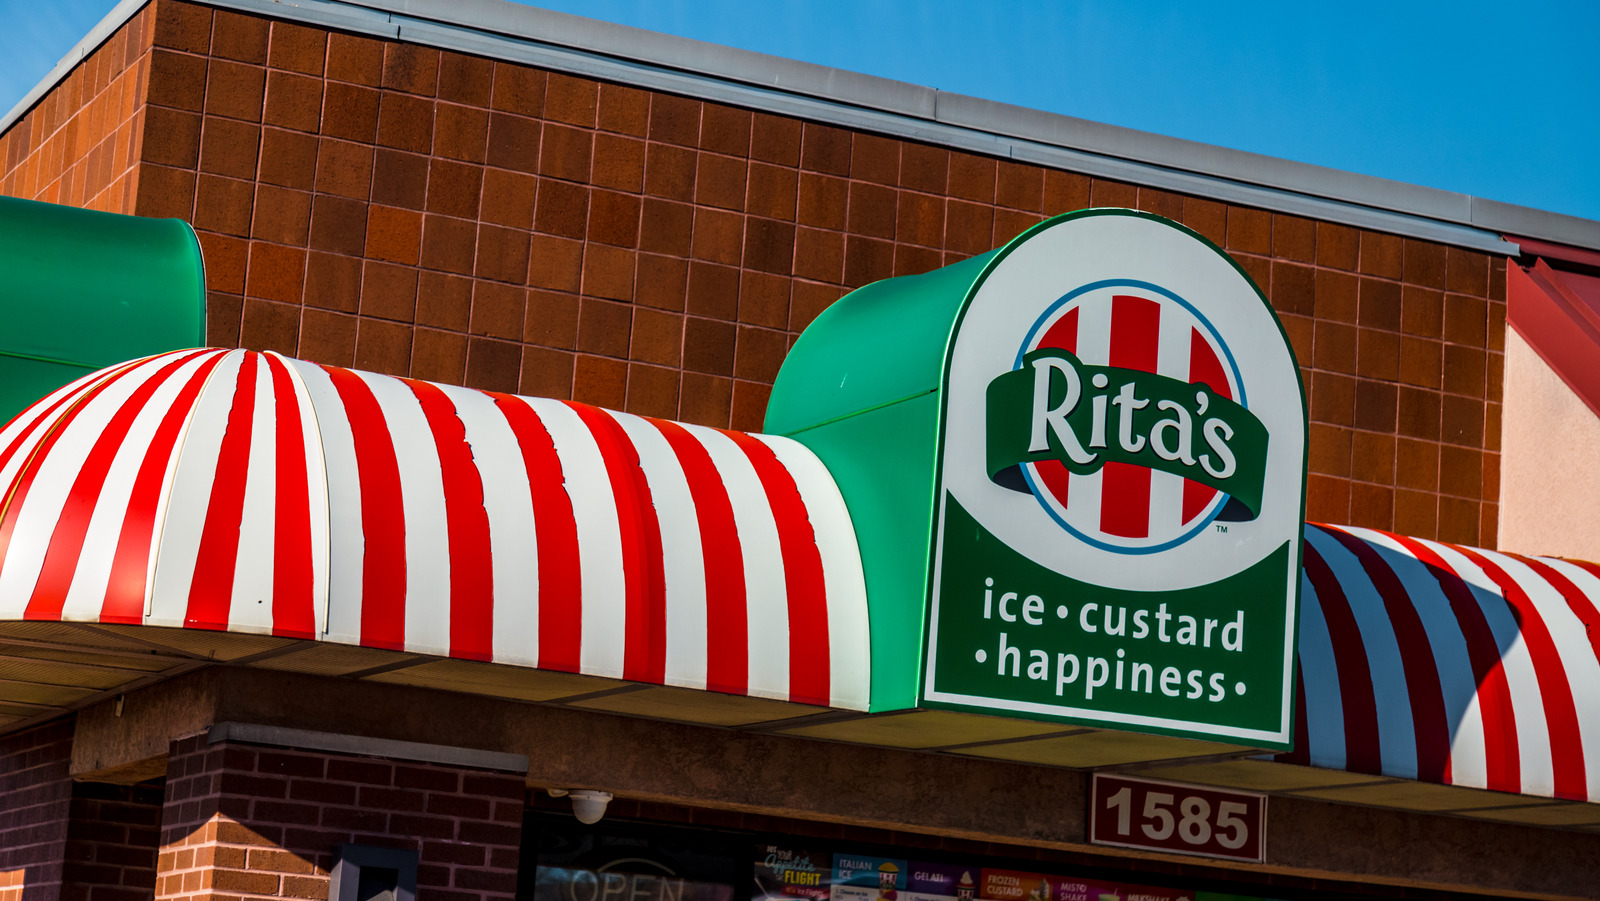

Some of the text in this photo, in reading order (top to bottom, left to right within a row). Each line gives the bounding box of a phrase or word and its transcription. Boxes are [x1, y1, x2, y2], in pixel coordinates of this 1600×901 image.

[1027, 356, 1238, 480] Rita's
[1216, 525, 1229, 534] TM
[983, 577, 1245, 652] ice custard
[997, 632, 1226, 702] happiness
[1106, 787, 1249, 850] 1585
[764, 853, 816, 875] Appetite
[839, 859, 873, 871] ITALIAN
[784, 870, 821, 886] FLIGHT
[838, 870, 852, 880] ICE
[914, 871, 944, 882] GELATI
[987, 875, 1020, 886] FROZEN
[570, 869, 684, 901] OPEN
[986, 885, 1023, 897] CUSTARD
